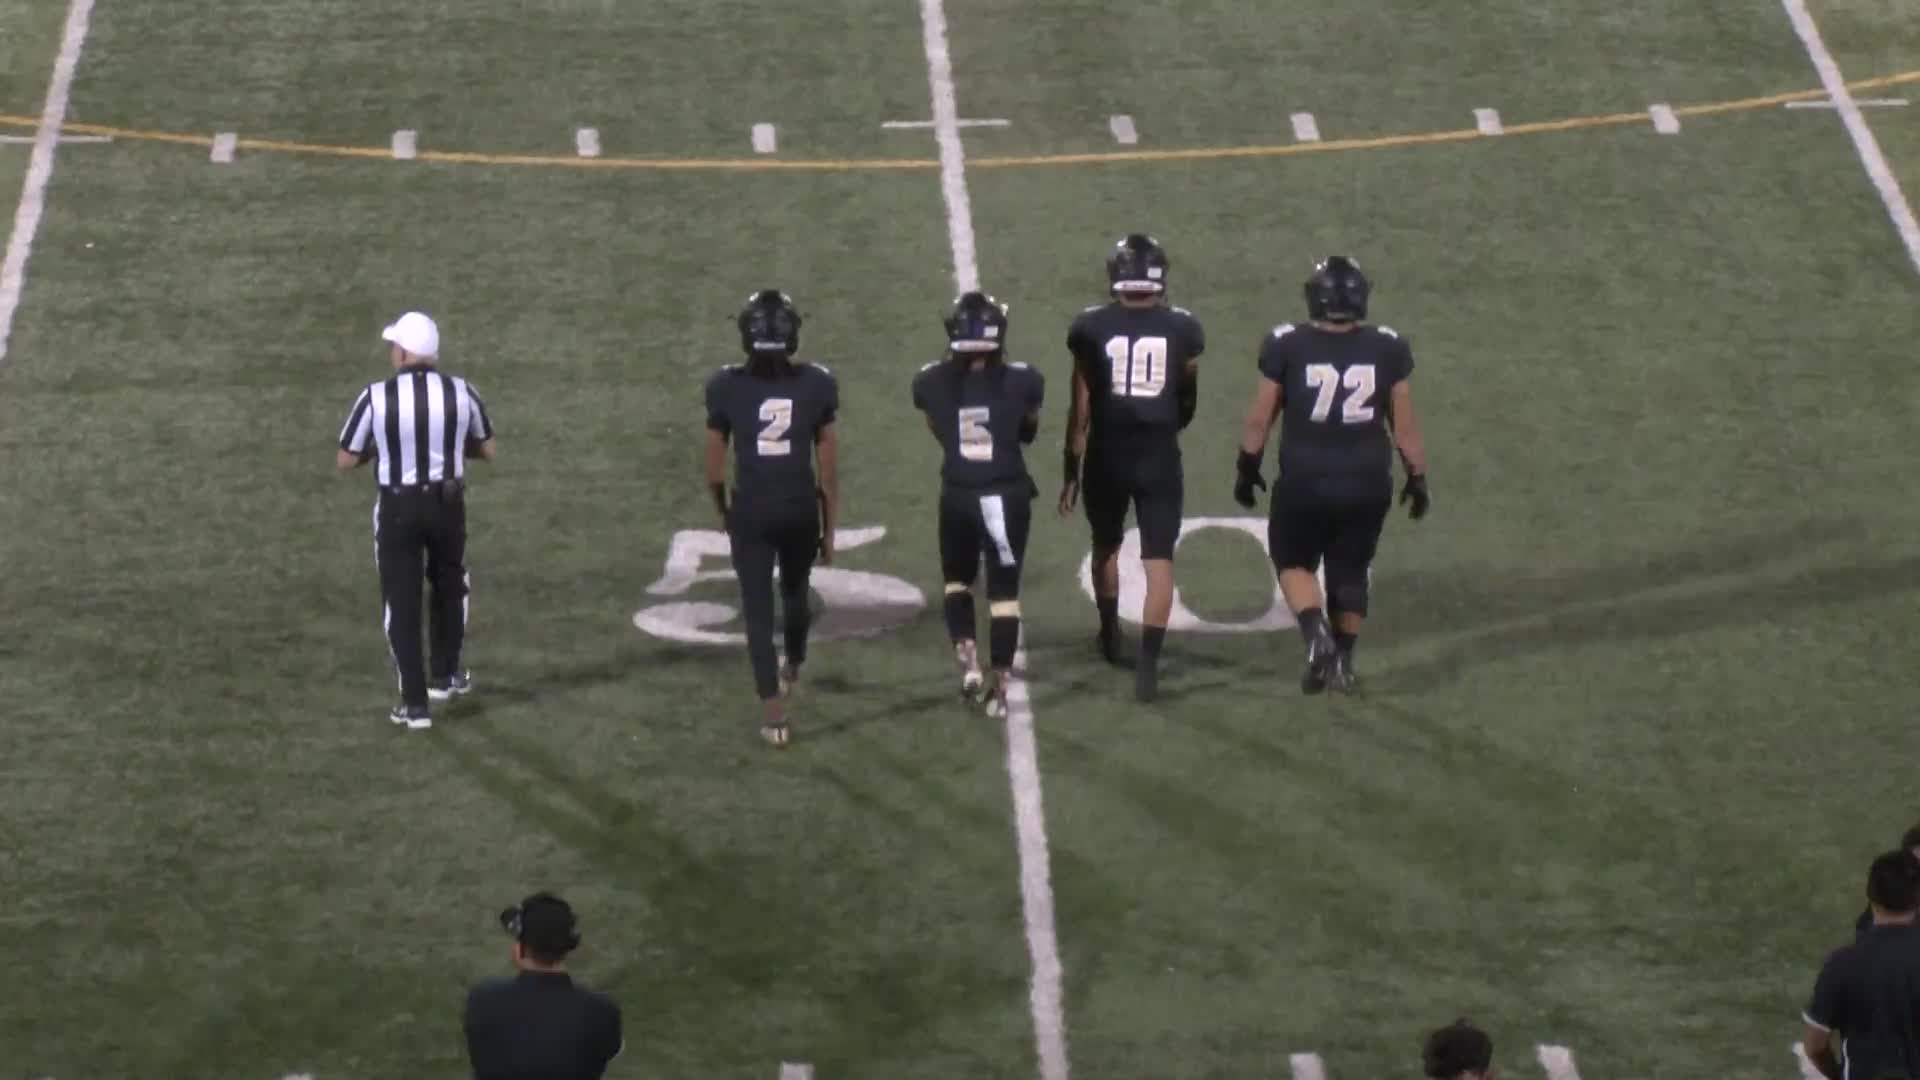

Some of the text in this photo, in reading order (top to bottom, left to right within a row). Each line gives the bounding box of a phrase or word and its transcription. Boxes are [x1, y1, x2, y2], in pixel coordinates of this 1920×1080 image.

[1105, 335, 1168, 397] 10
[1306, 363, 1376, 424] 72
[757, 398, 793, 457] 2
[958, 406, 993, 461] 5
